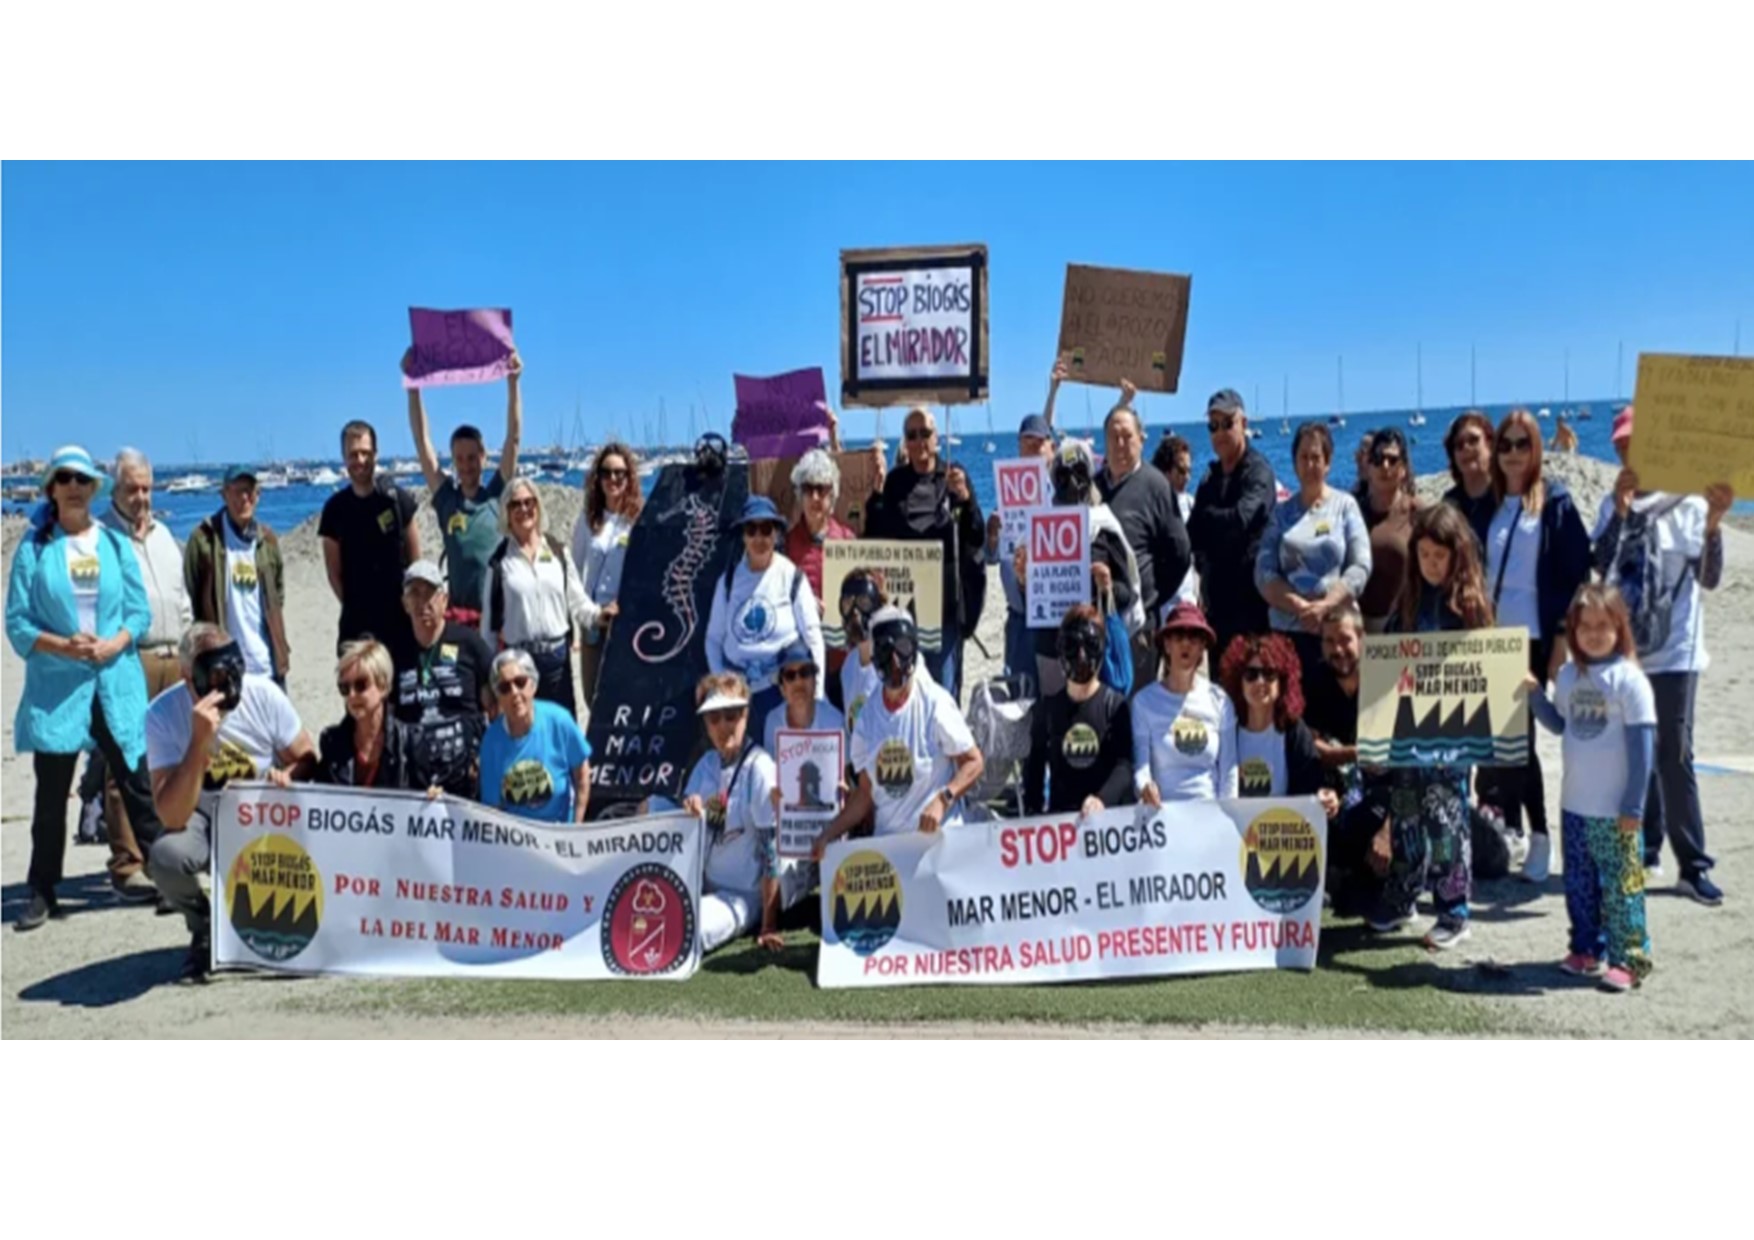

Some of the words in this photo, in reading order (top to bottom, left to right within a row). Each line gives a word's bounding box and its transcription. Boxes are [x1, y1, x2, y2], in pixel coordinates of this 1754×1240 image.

[859, 286, 908, 316] STOP
[861, 333, 885, 367] EL
[1002, 471, 1039, 502] NO
[1036, 520, 1078, 557] NO
[1366, 645, 1397, 659] PORQUE
[1400, 639, 1421, 658] NO
[1416, 663, 1441, 678] STOP
[1416, 679, 1441, 696] MAR
[1444, 677, 1488, 695] MENOR
[605, 734, 665, 757] MAR
[238, 802, 300, 829] STOP
[308, 805, 395, 836] BIOGÁS
[407, 815, 455, 840] MAR
[461, 818, 540, 850] MENOR
[556, 839, 582, 858] EL
[587, 830, 684, 856] MIRADOR
[1000, 822, 1077, 868] STOP
[1084, 820, 1167, 858] BIOGÁS
[334, 874, 381, 896] POR
[396, 878, 494, 908] NUESTRA
[499, 890, 569, 913] SALUD
[582, 895, 595, 914] Y
[947, 895, 994, 928] MAR
[1000, 886, 1077, 921] MENOR
[1097, 880, 1125, 910] EL
[1130, 871, 1227, 906] MIRADOR
[360, 916, 384, 937] LA
[390, 918, 428, 941] DEL
[433, 921, 480, 946] MAR
[490, 926, 565, 951] MENOR
[864, 953, 908, 976] POR
[913, 943, 1014, 976] NUESTRA
[1019, 933, 1092, 967] SALUD
[1097, 925, 1208, 959] PRESENTE
[1213, 926, 1226, 952] Y
[1231, 919, 1315, 950] FUTURA
